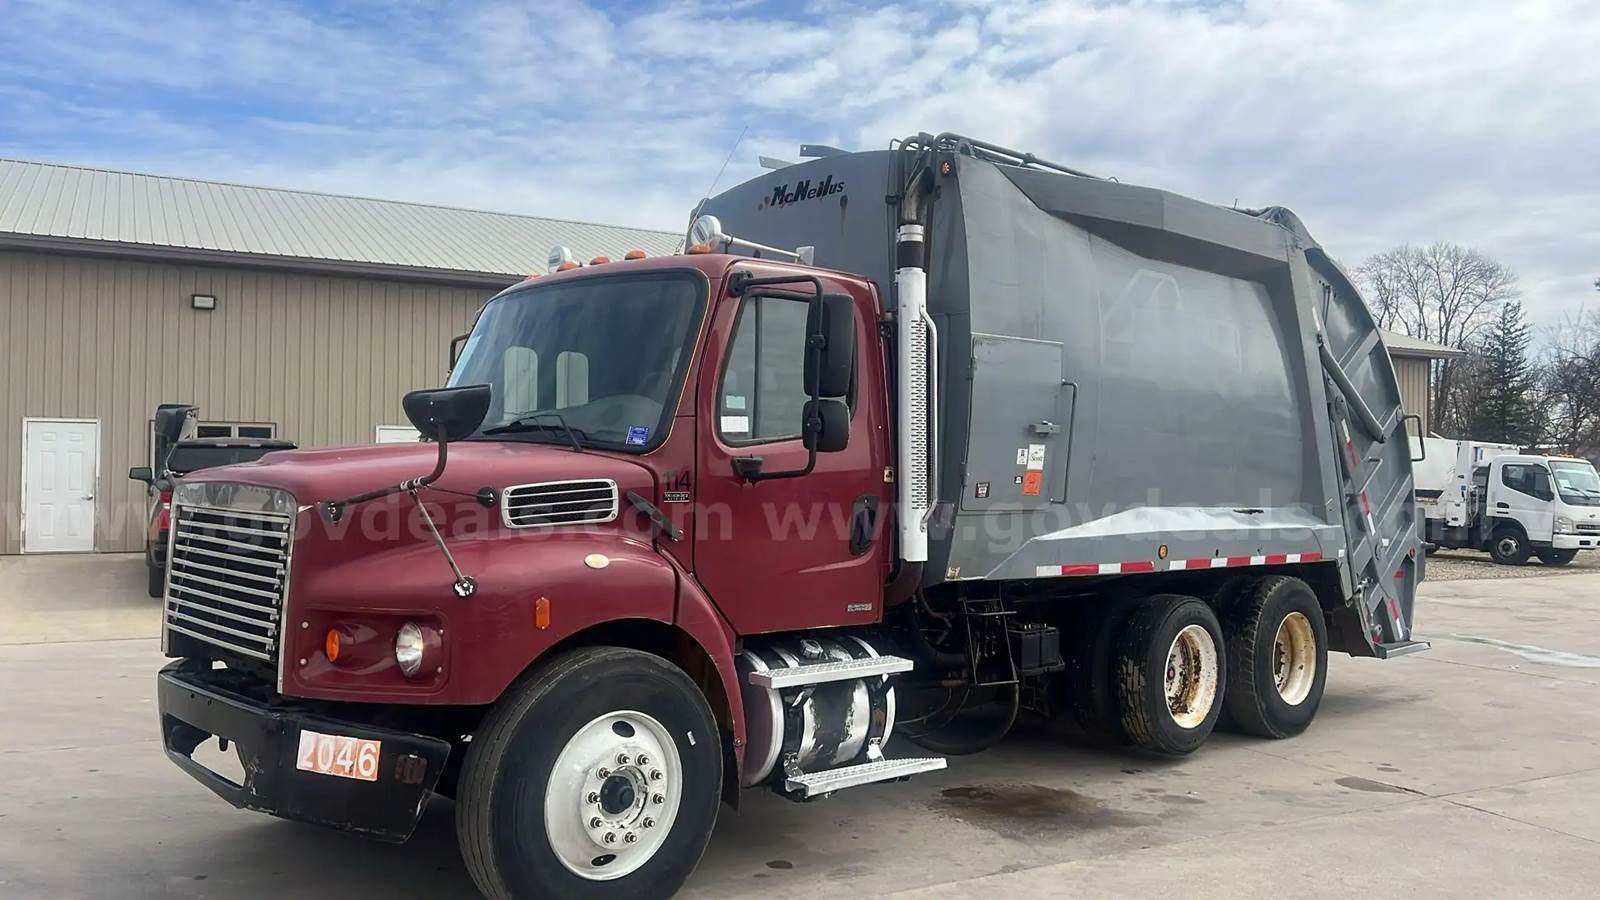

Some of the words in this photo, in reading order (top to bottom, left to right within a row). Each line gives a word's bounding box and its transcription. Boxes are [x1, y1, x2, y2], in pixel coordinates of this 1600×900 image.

[770, 174, 845, 207] McNeilus
[663, 470, 691, 491] 114
[299, 735, 377, 777] 2046
